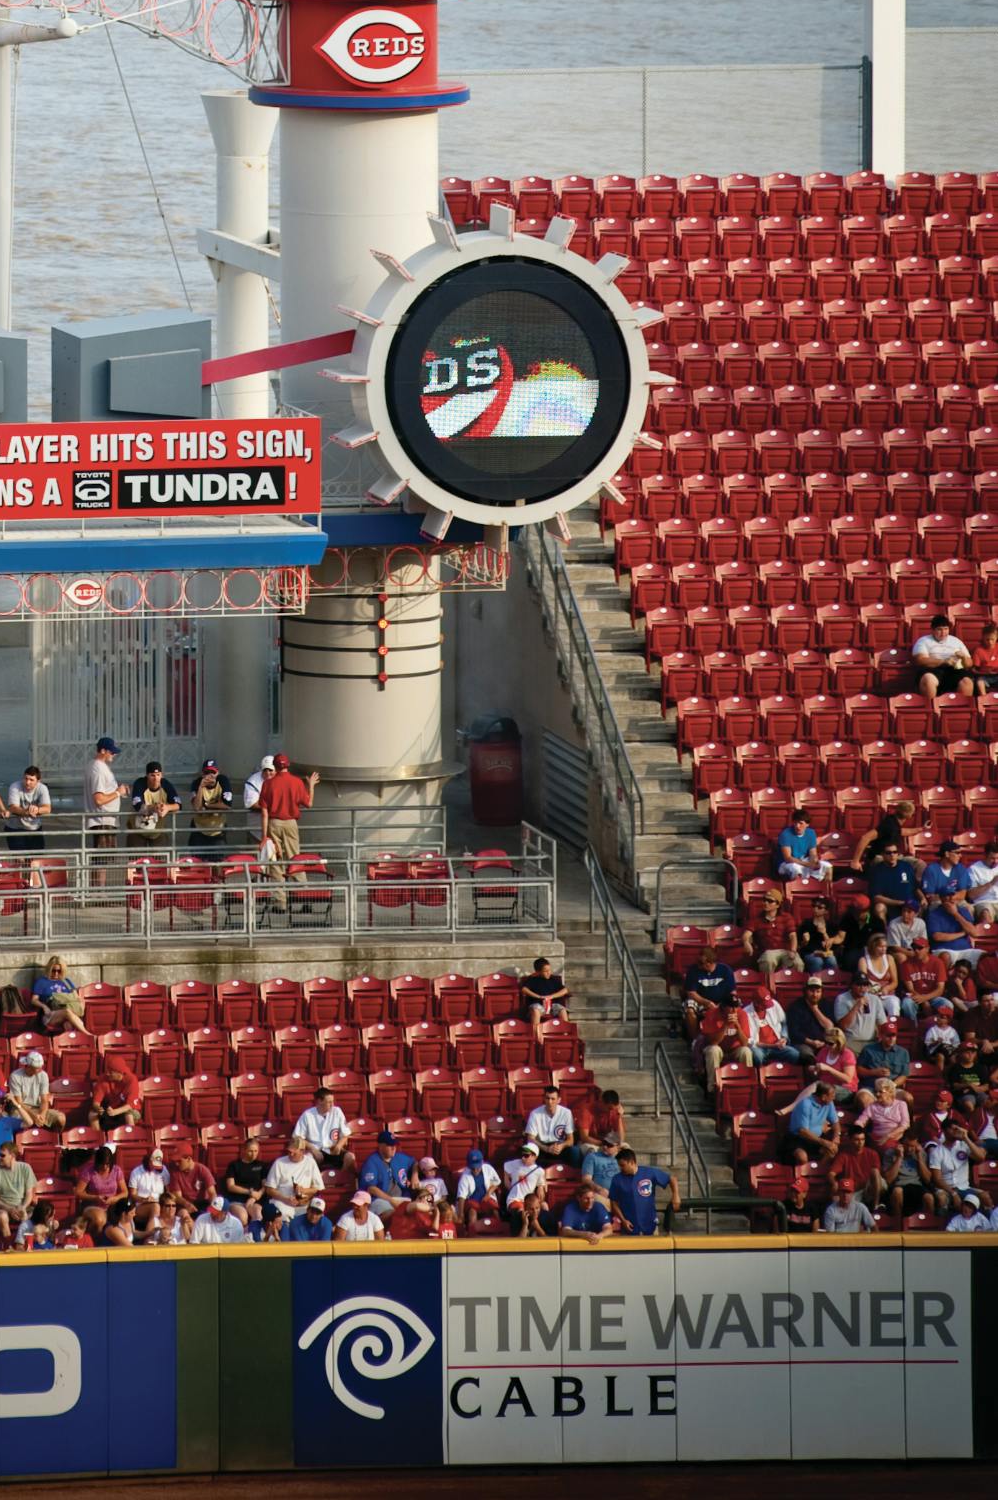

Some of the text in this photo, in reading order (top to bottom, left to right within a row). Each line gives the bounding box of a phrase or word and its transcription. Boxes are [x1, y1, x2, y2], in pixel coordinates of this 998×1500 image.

[352, 36, 425, 57] REDS
[90, 432, 154, 462] HITS
[162, 430, 227, 461] THIS
[236, 429, 313, 464] SIGN,
[42, 477, 63, 506] A
[124, 471, 279, 504] TUNDRA
[74, 471, 111, 480] TOYOTA
[74, 501, 111, 509] TRUCKS
[449, 1290, 960, 1353] TIME WARNER
[450, 1374, 677, 1420] CABLE
